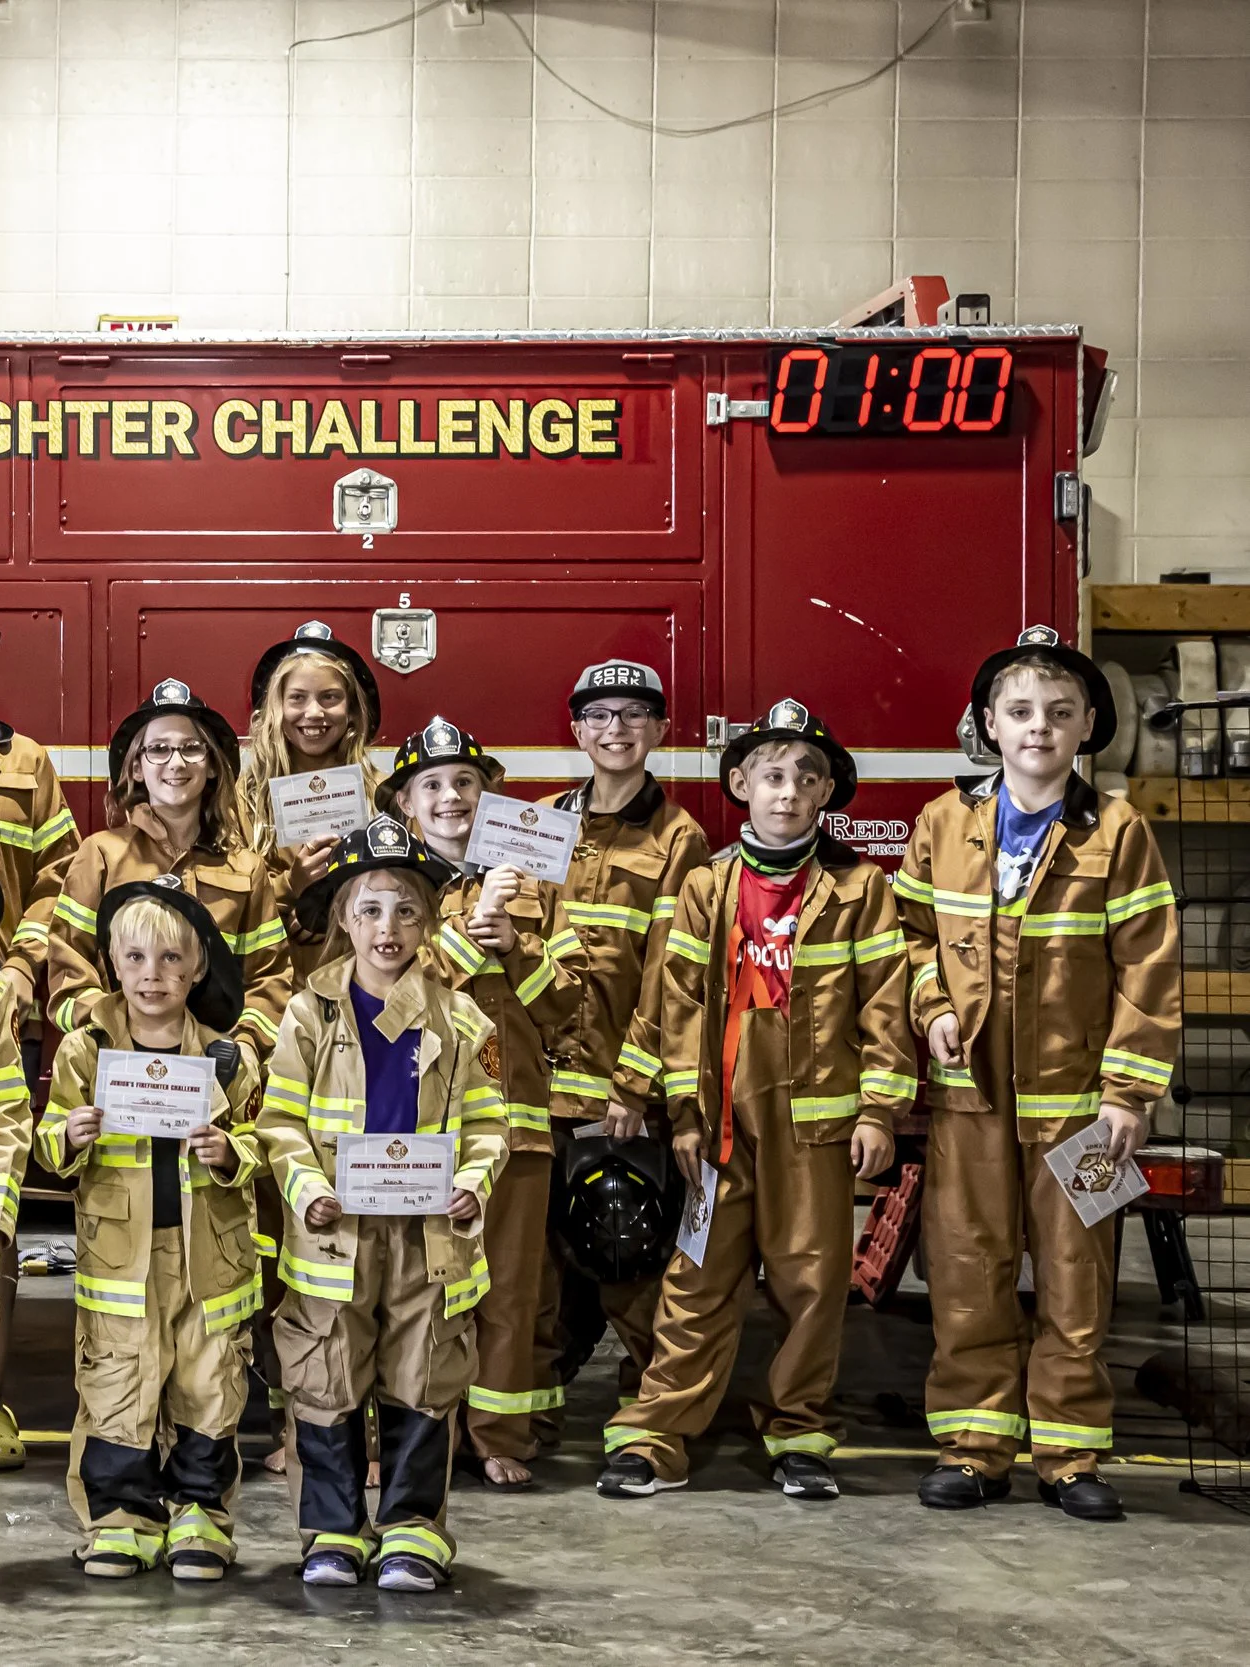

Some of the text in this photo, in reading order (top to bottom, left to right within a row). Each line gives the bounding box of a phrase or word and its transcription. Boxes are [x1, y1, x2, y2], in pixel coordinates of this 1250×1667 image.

[770, 348, 1013, 433] 01:00
[212, 398, 618, 457] CHALLENGE
[362, 533, 374, 549] 2
[398, 592, 411, 609] 5
[594, 667, 629, 678] ZOO
[593, 676, 640, 686] YORK
